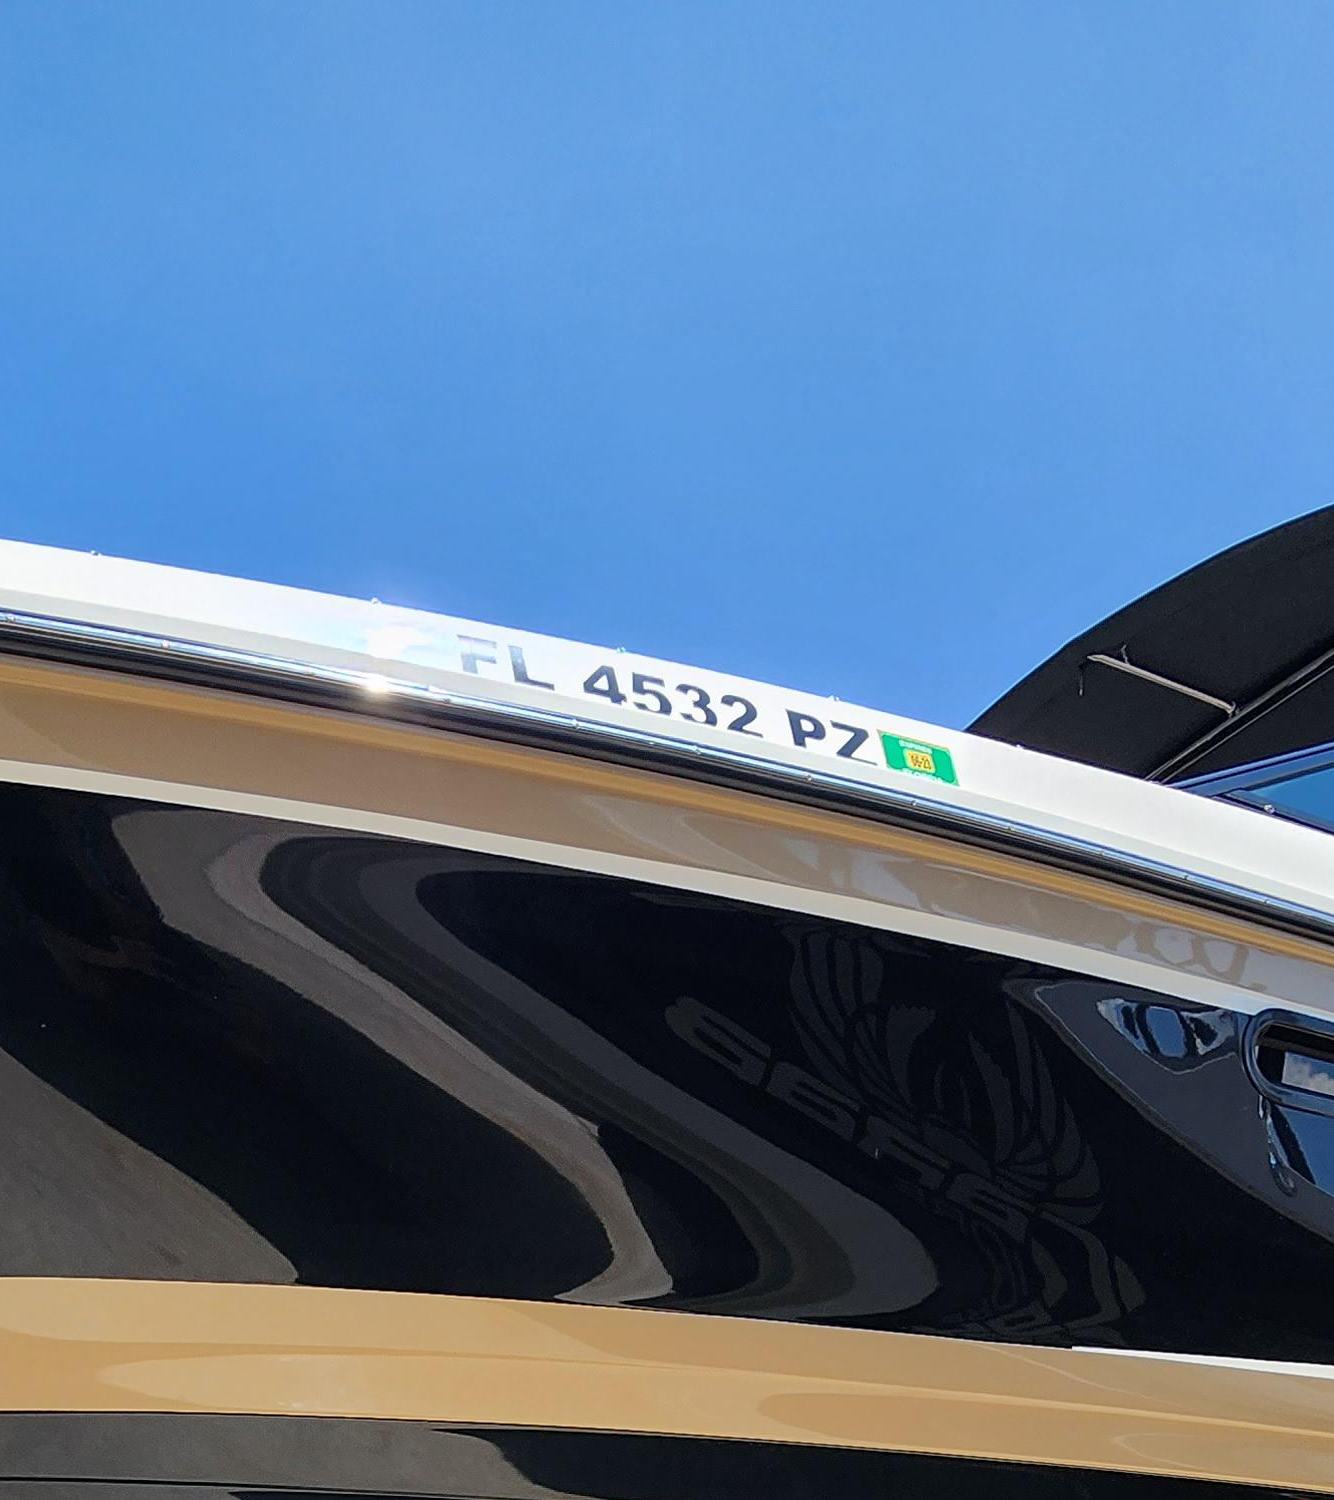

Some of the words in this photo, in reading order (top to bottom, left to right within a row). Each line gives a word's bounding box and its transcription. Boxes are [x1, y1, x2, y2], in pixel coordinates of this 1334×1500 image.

[457, 634, 555, 691] FL
[583, 665, 763, 738] 4532
[785, 709, 877, 766] PZ
